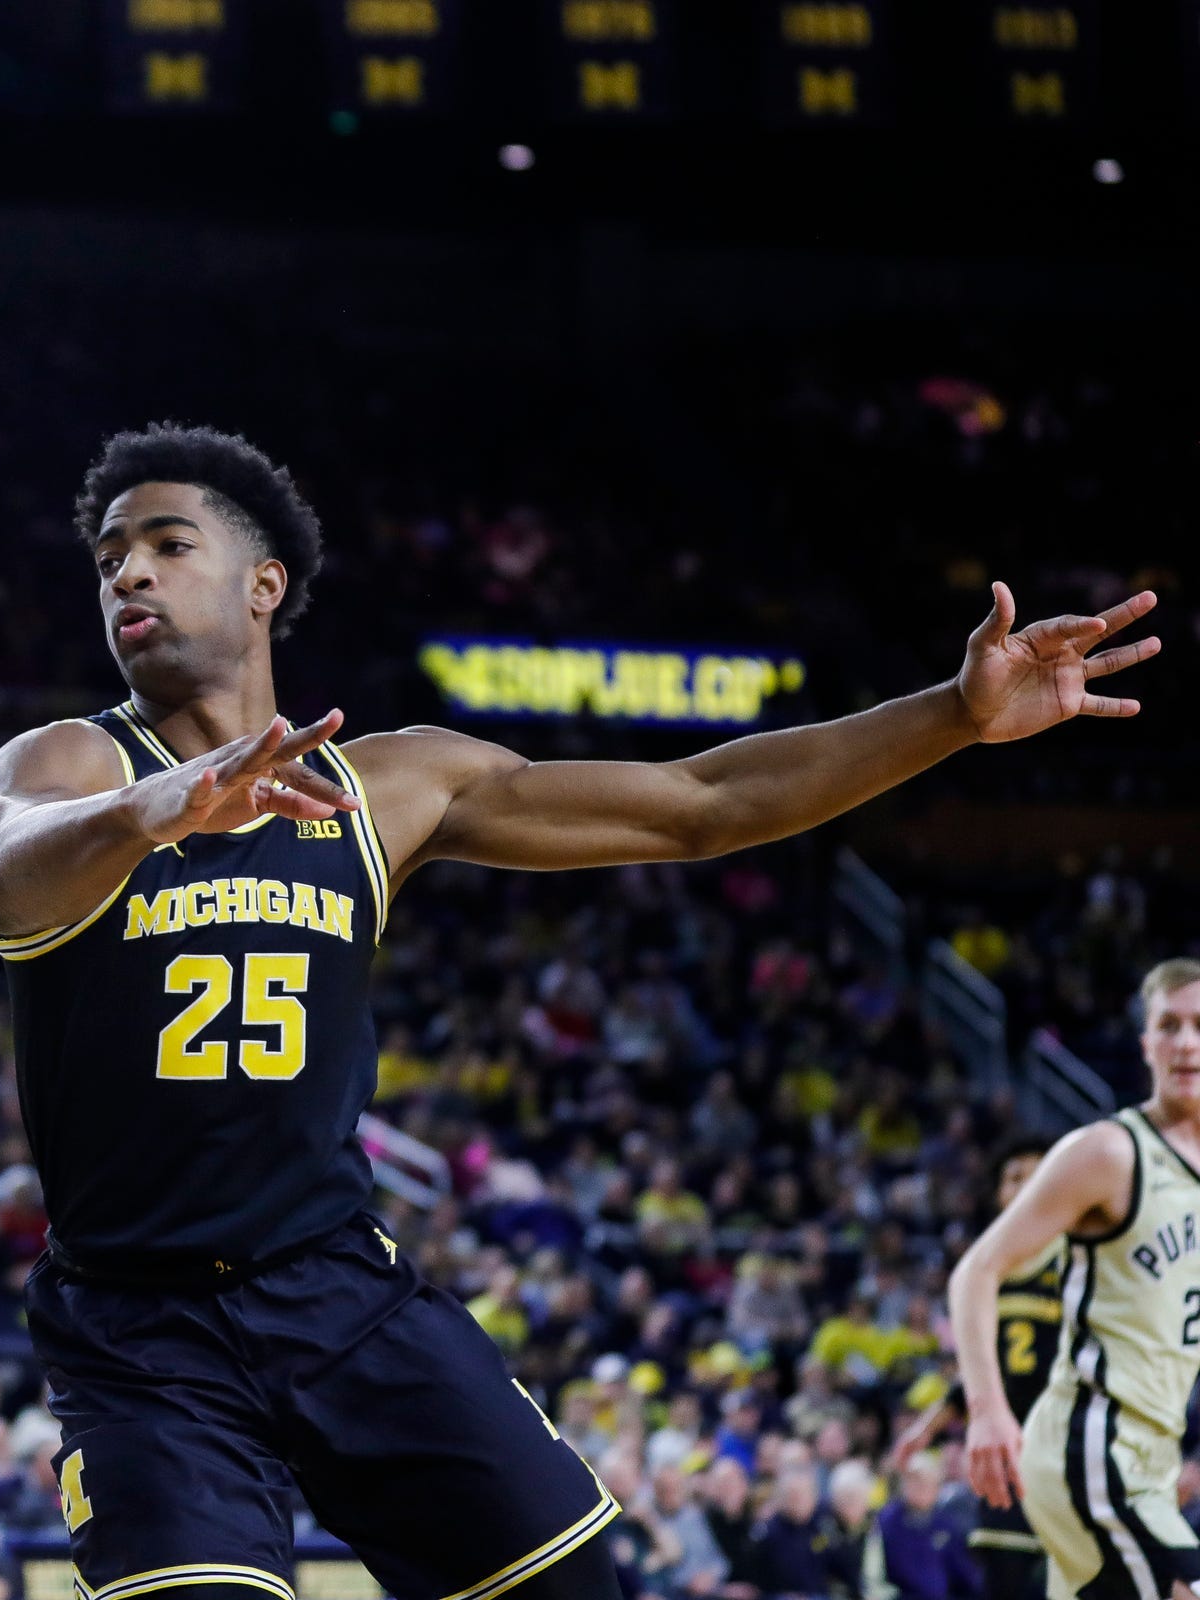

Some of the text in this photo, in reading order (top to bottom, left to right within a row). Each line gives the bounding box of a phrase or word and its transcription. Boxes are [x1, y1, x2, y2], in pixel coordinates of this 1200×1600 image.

[123, 877, 355, 943] MICHIGAN
[156, 953, 310, 1080] 25
[1005, 1320, 1037, 1375] 2
